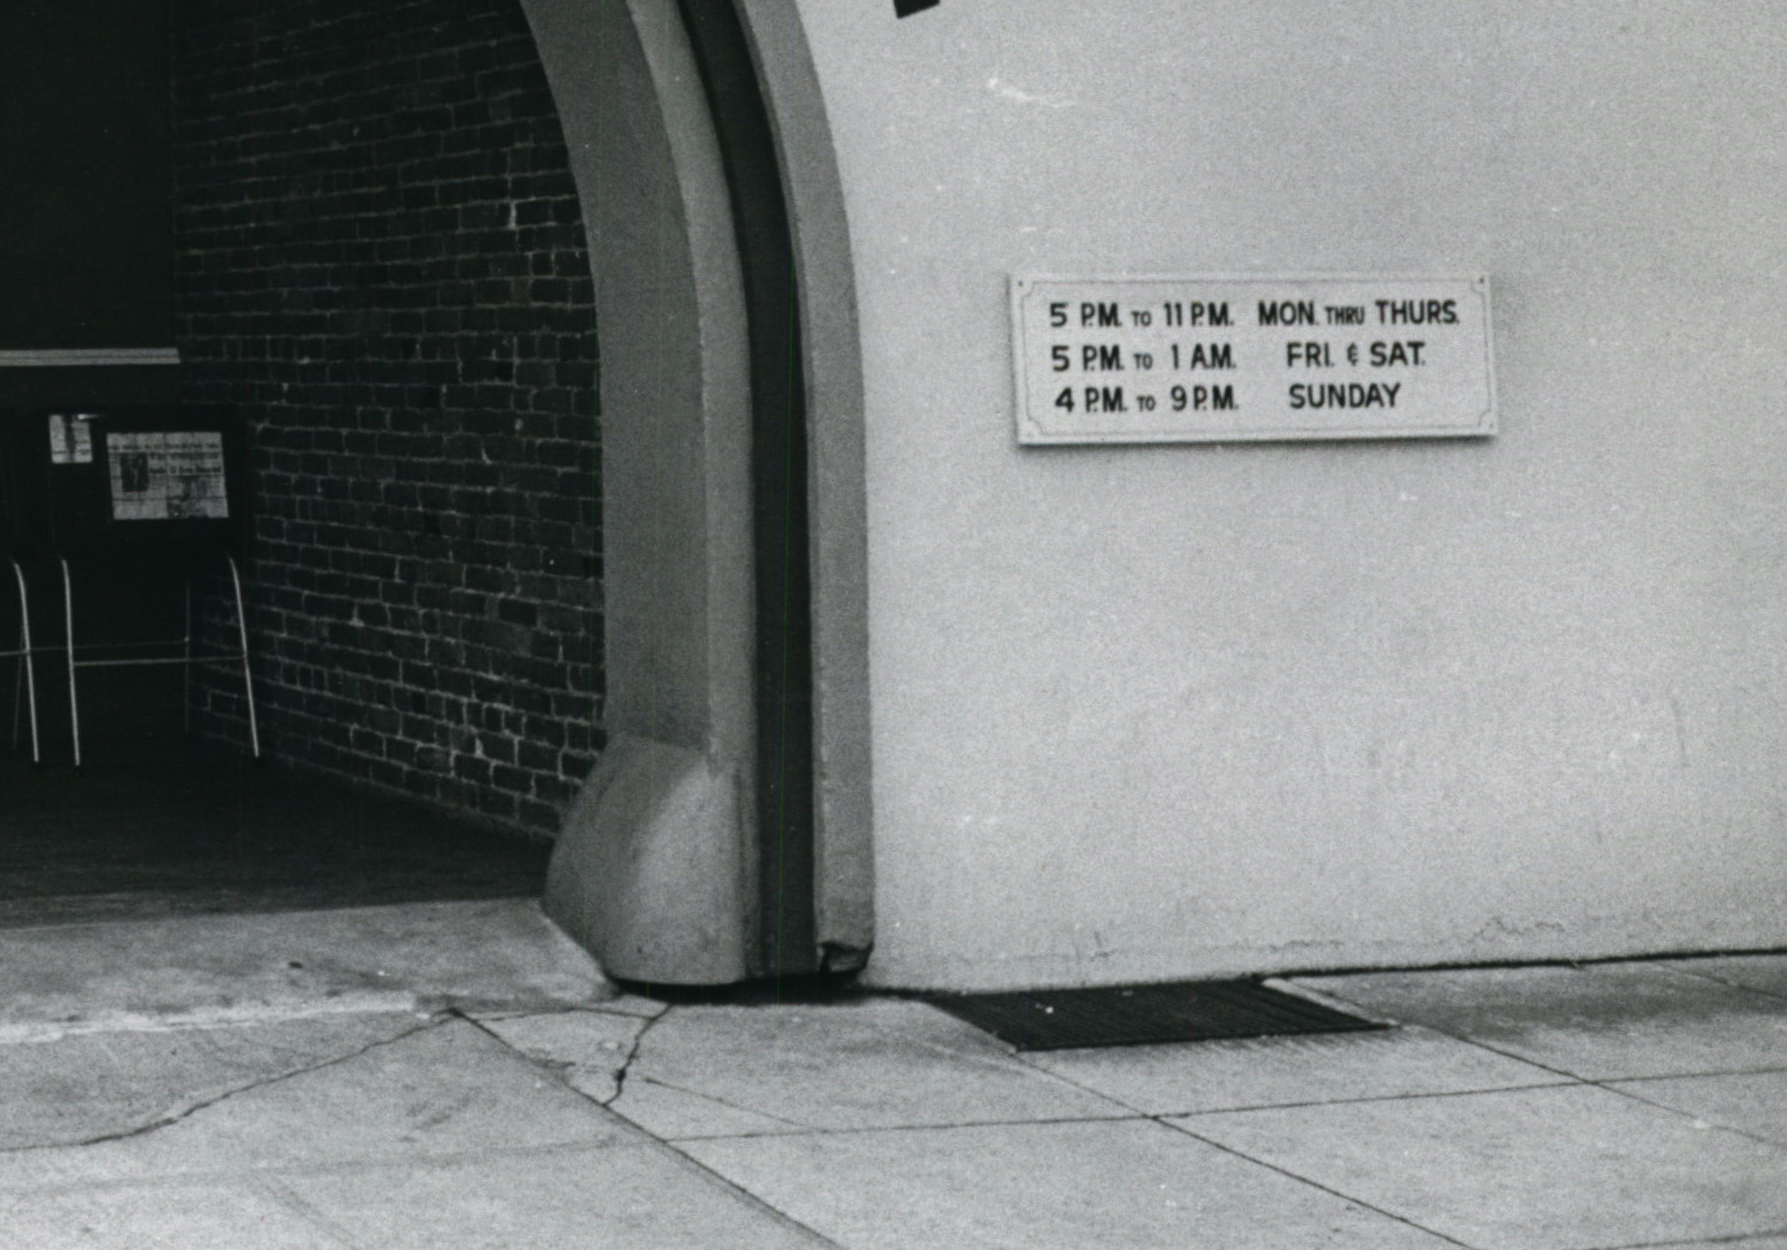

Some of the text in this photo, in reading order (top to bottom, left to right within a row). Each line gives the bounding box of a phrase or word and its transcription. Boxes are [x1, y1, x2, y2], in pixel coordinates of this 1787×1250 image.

[1050, 299, 1461, 327] 5 P.M. TO 11 P.M. MON. THRU THURS.
[1051, 345, 1070, 372] 5
[1082, 344, 1124, 372] P.M.
[1133, 353, 1154, 370] TO
[1171, 343, 1180, 370] 1
[1190, 343, 1236, 370] A.M.
[1286, 341, 1335, 368] FRI.
[1369, 341, 1427, 368] SAT.
[1055, 382, 1402, 414] 4 P.M. TO 9 P.M. SUNDAY
